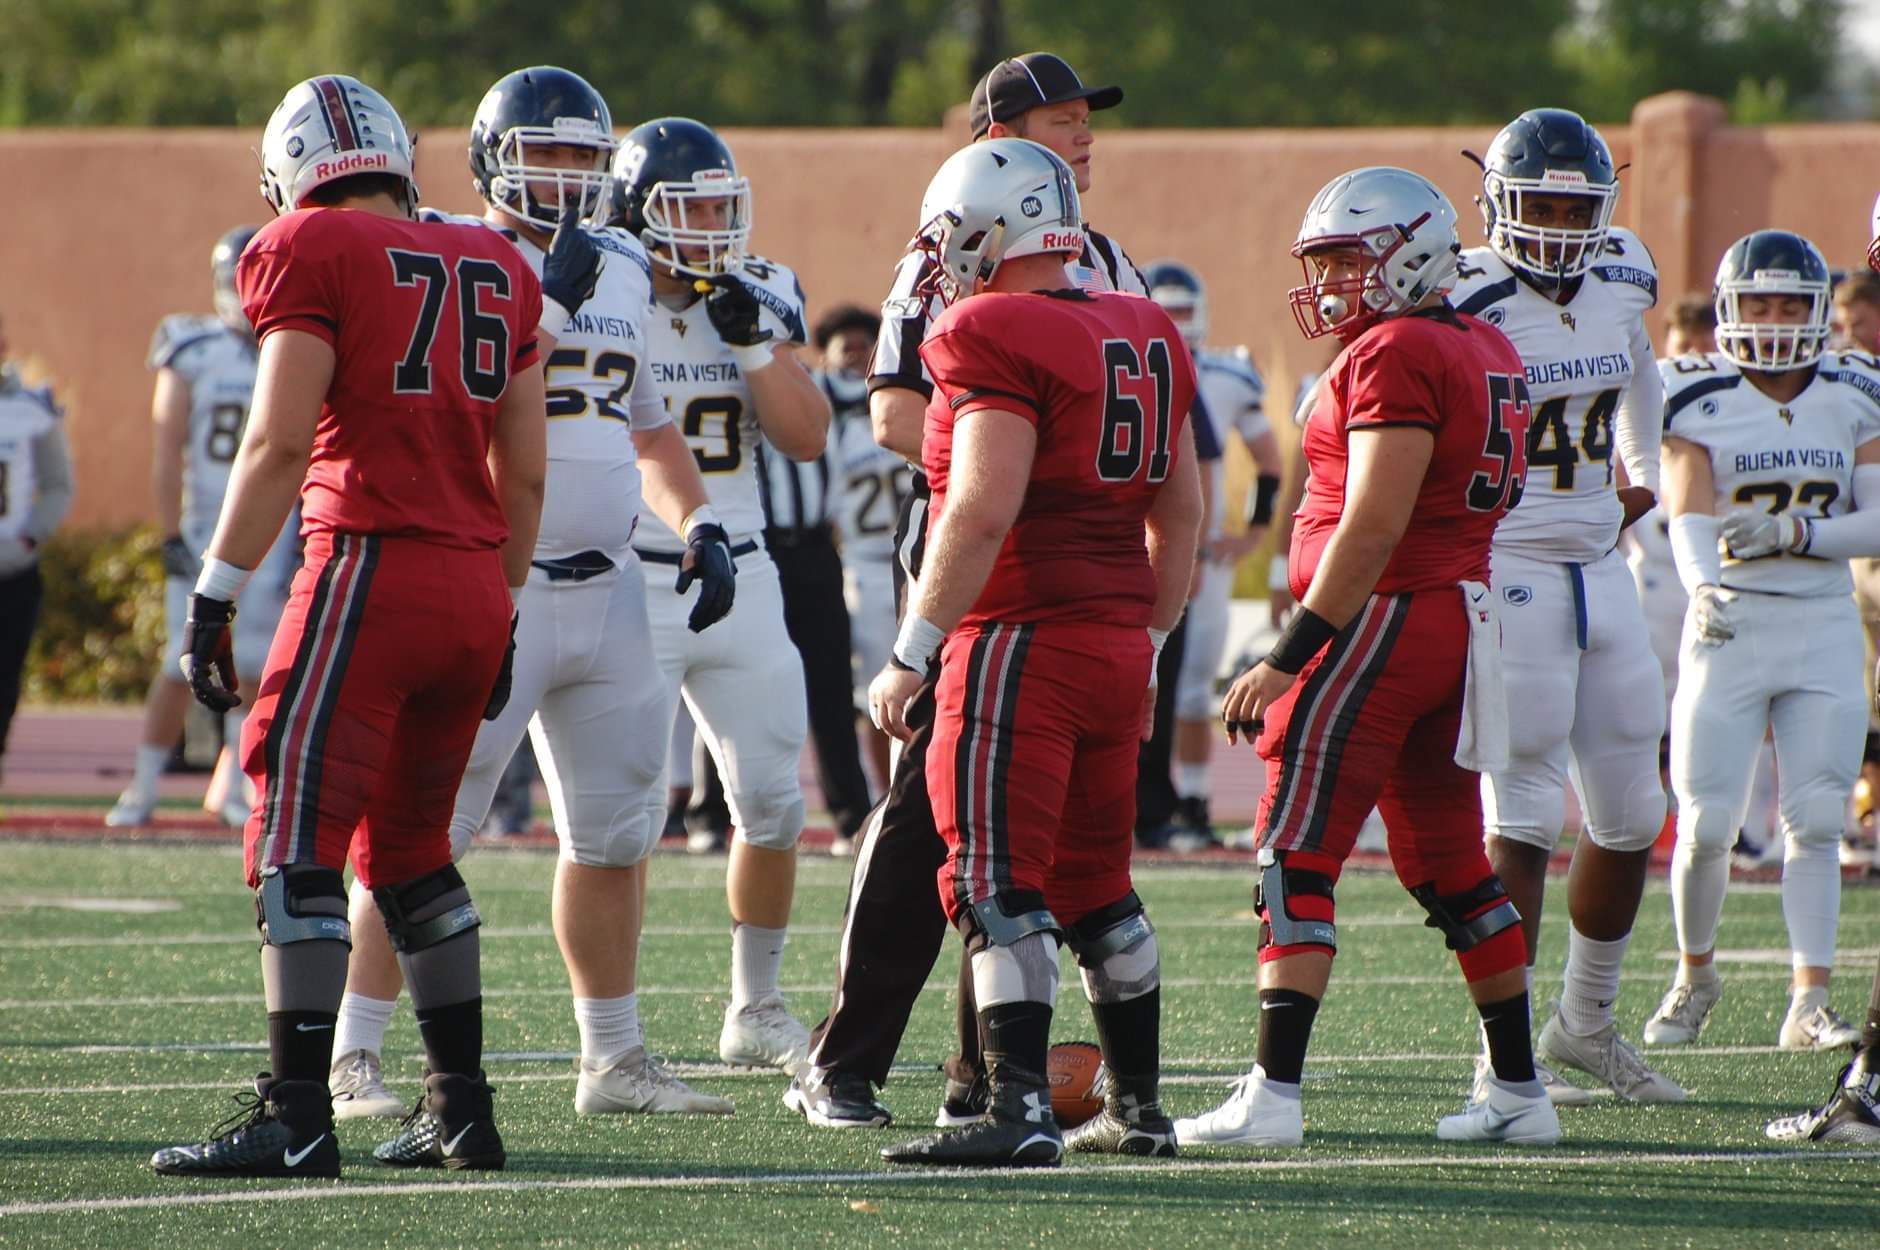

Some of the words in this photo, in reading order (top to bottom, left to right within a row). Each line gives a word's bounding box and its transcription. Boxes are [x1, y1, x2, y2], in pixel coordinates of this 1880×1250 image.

[315, 153, 388, 179] Riddell
[1022, 199, 1040, 216] BK
[1042, 231, 1085, 250] Ridde
[1606, 266, 1652, 290] BEAVERS
[744, 283, 789, 319] EAVERS
[384, 247, 512, 403] 76
[563, 314, 593, 334] ENA
[594, 315, 636, 341] VISTA
[651, 362, 687, 382] ENA
[688, 362, 739, 382] VISTA
[1524, 359, 1584, 385] BUENA
[1586, 353, 1630, 377] VISTA
[1838, 370, 1880, 399] BEAVER
[1095, 337, 1172, 484] 61
[208, 403, 244, 462] 8
[1465, 371, 1531, 512] 53
[1528, 385, 1622, 491] 44
[1735, 450, 1796, 473] BUENA
[1799, 448, 1845, 470] VISTA
